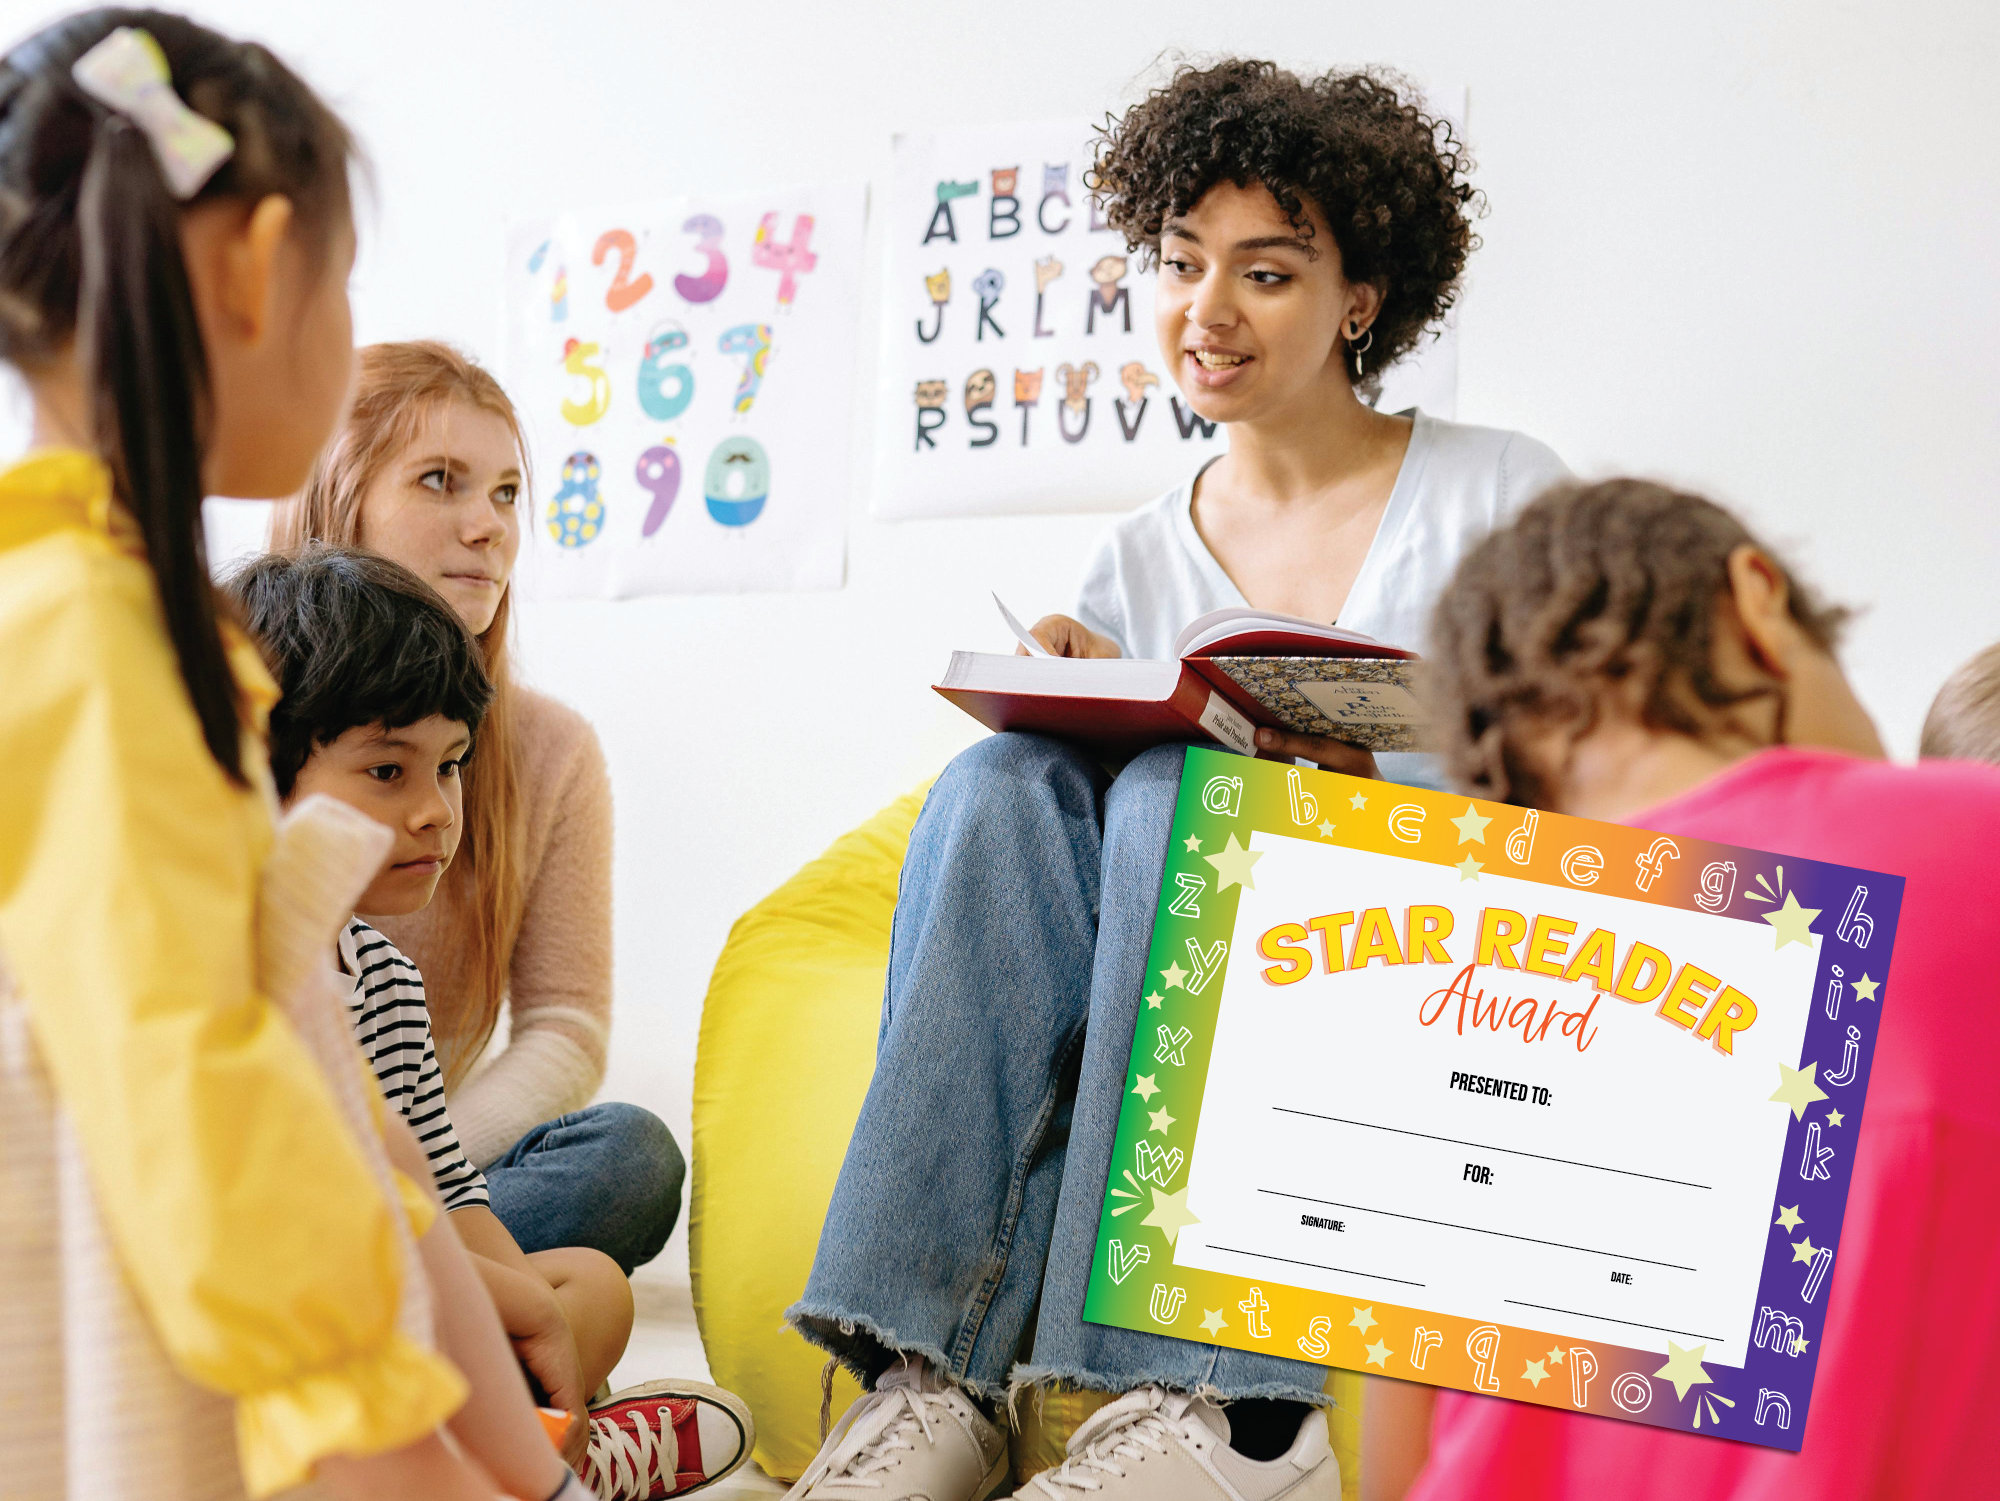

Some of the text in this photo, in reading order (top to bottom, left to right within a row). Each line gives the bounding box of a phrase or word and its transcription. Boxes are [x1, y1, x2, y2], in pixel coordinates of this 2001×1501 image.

[922, 200, 958, 245] A
[989, 195, 1022, 241] B
[1038, 190, 1071, 235] C
[591, 228, 654, 314] 2
[673, 213, 729, 305] 3
[751, 210, 819, 305] 4
[916, 287, 1133, 344] J K L M
[560, 323, 773, 427] 5 6 7
[913, 405, 947, 453] R
[967, 400, 999, 447] S
[1014, 400, 1039, 447] T
[1059, 397, 1092, 445] U
[1115, 397, 1149, 442] V
[546, 434, 771, 549] 8 9 0
